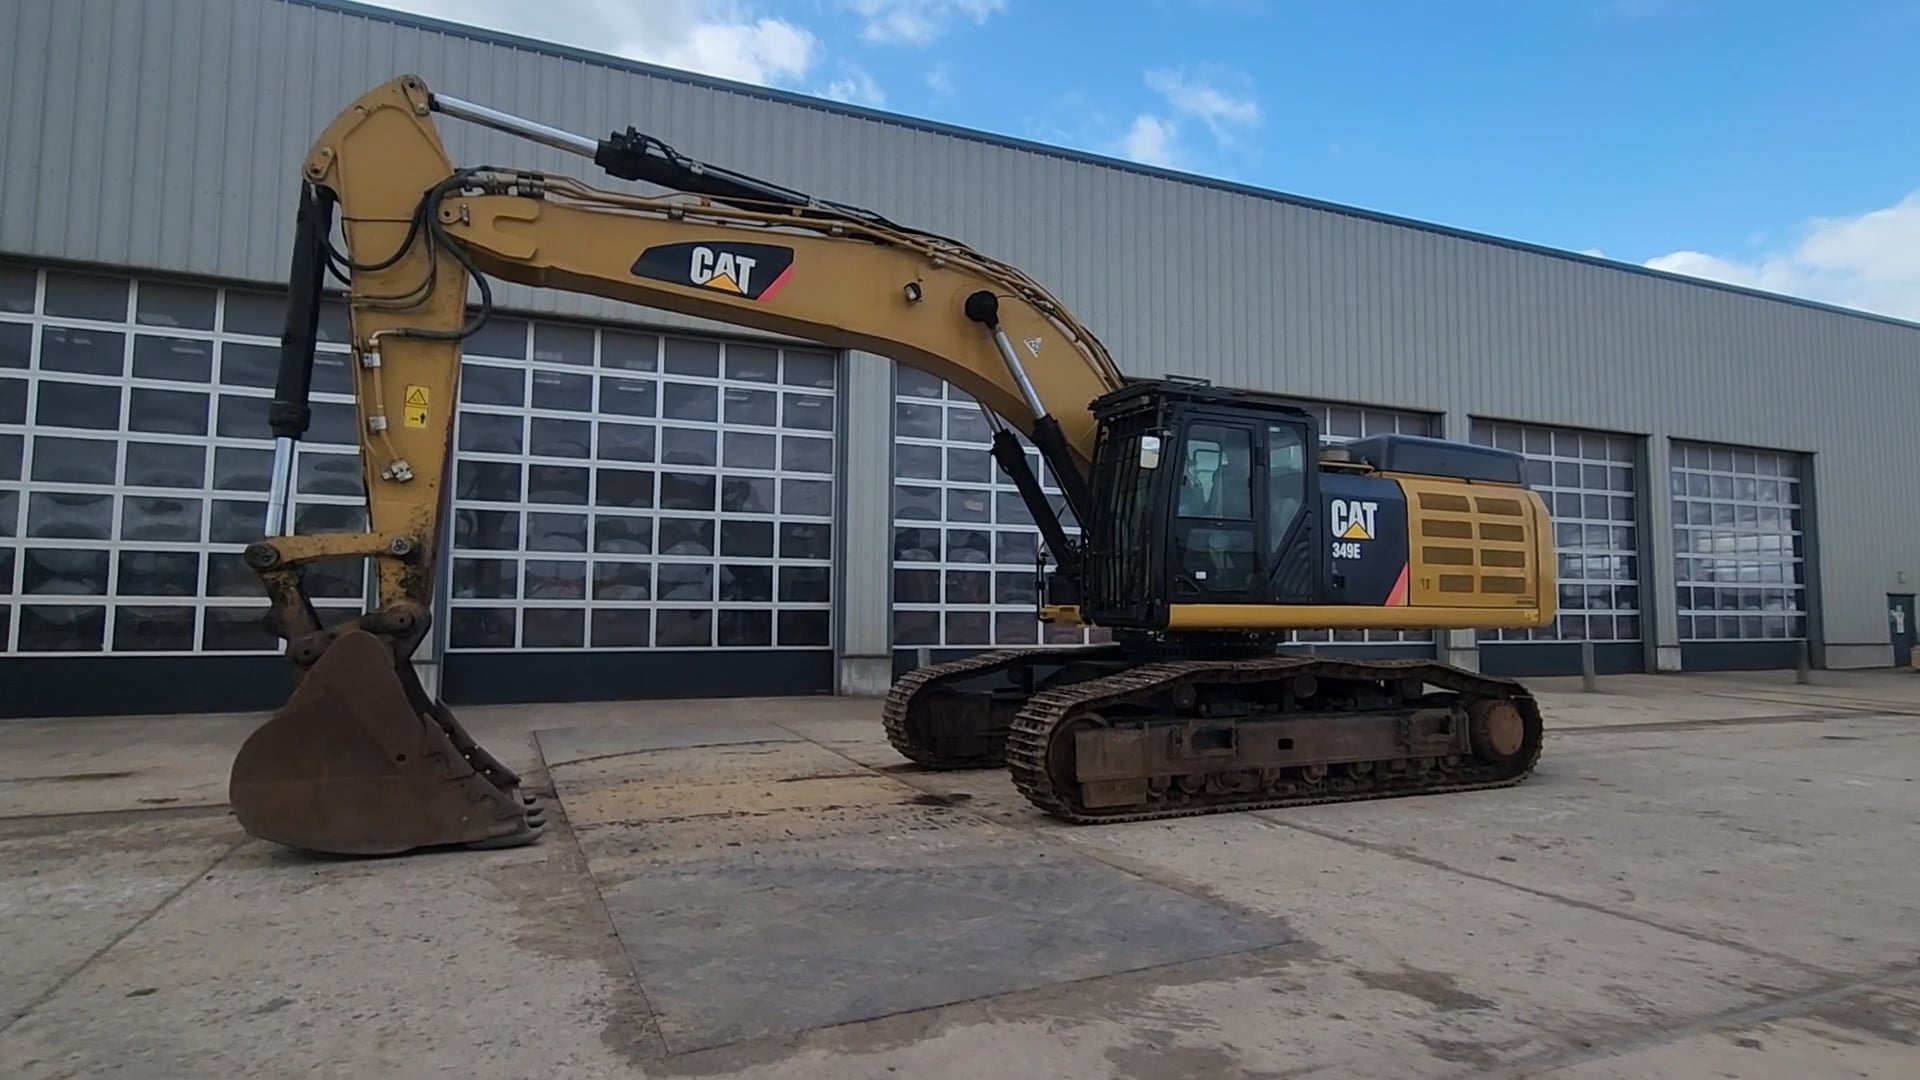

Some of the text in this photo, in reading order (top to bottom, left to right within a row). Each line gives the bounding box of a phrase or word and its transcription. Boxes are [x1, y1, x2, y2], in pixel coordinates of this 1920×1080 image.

[690, 246, 757, 295] CAT
[1331, 499, 1378, 540] CAT
[1332, 542, 1361, 559] 349E
